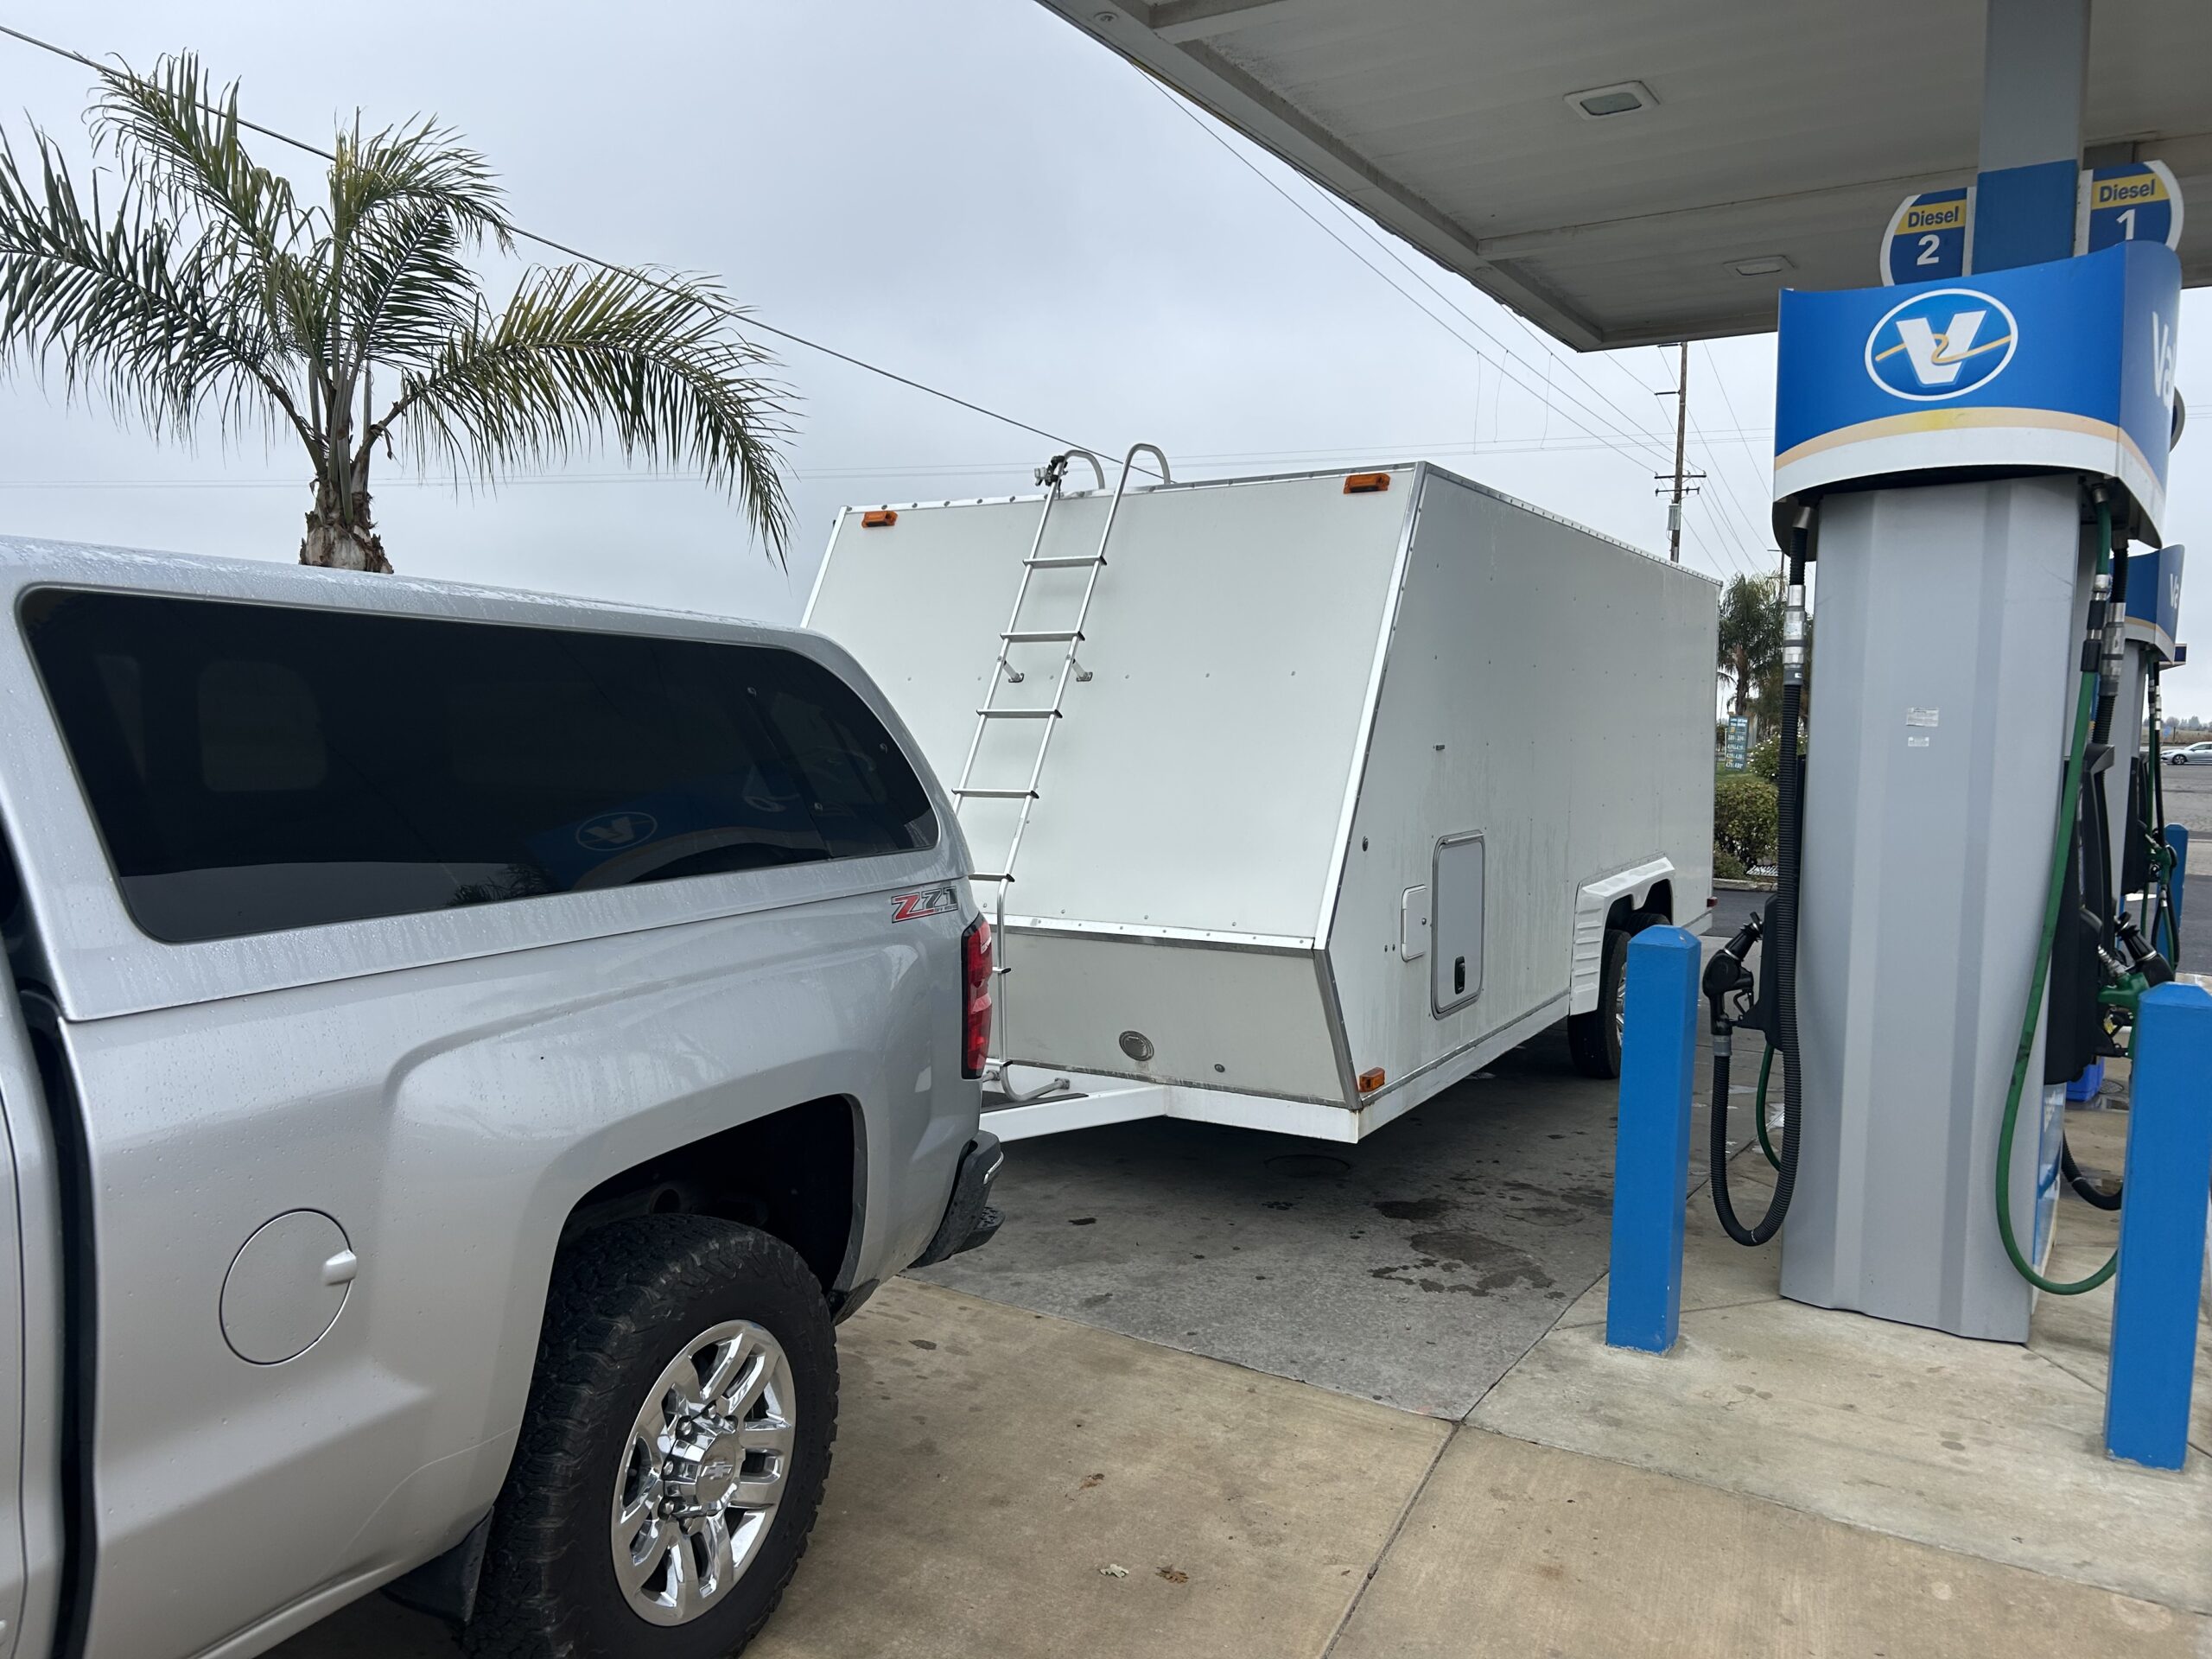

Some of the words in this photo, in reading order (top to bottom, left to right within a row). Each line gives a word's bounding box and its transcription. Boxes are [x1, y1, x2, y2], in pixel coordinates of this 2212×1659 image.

[2099, 178, 2156, 202] Diesel
[1908, 206, 1959, 228] Diesel
[2115, 208, 2136, 241] 1
[1916, 233, 1940, 266] 2
[891, 886, 957, 924] Z71
